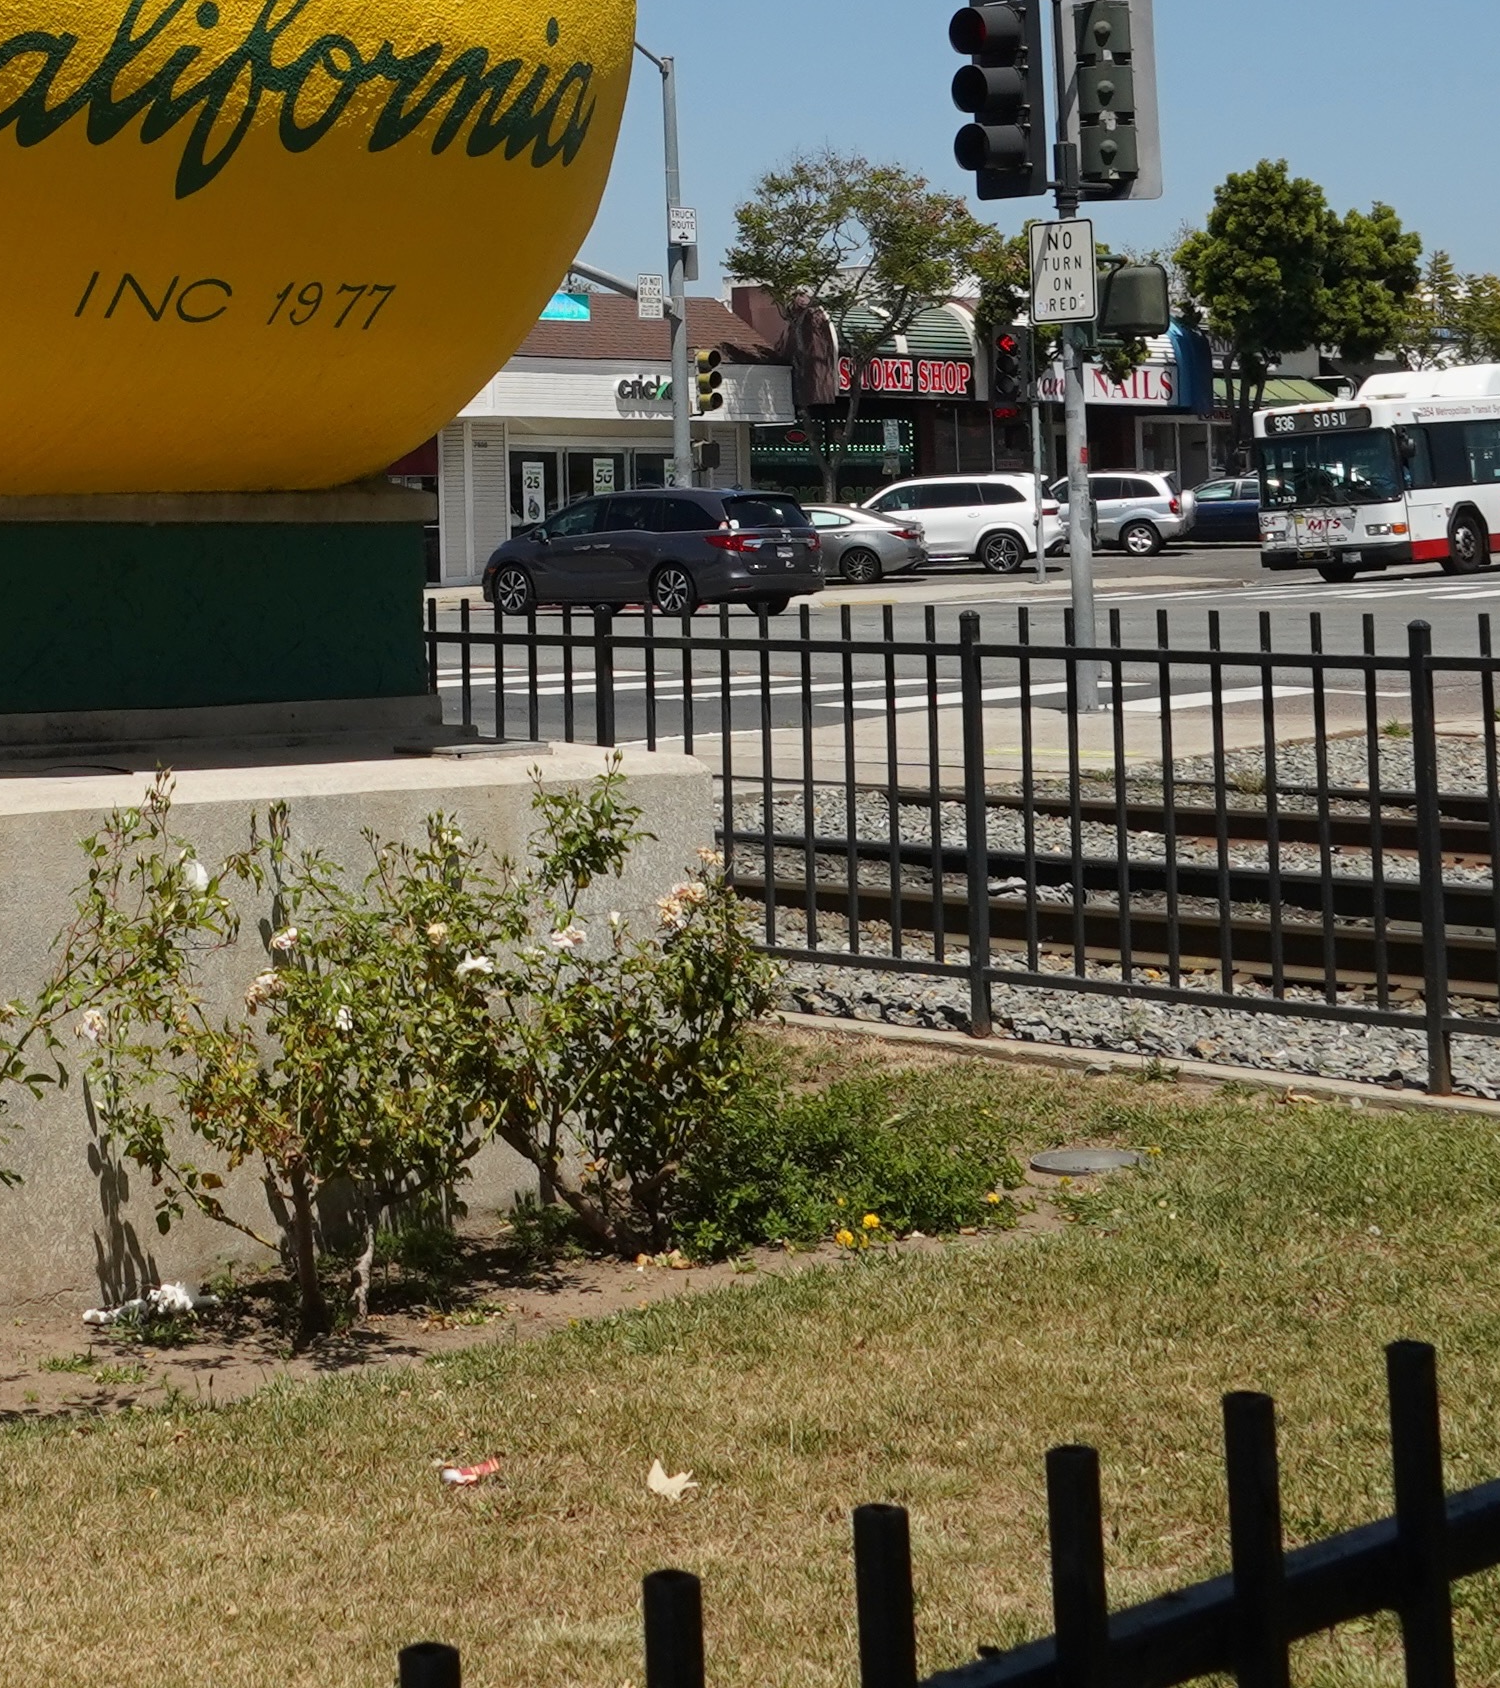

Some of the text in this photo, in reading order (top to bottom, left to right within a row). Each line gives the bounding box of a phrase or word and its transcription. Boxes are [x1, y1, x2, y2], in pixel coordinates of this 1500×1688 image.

[671, 210, 695, 219] TRUCK
[671, 220, 695, 230] ROUTE
[1047, 231, 1073, 252] NO
[1043, 255, 1083, 273] TURN
[639, 276, 661, 287] DO NOT
[1053, 277, 1073, 292] ON
[73, 269, 397, 330] INC 1977
[639, 286, 662, 297] BLOCK
[1049, 297, 1078, 313] RED
[917, 361, 971, 394] SHOP
[1090, 367, 1173, 401] NAILS
[617, 374, 673, 401] crick
[1273, 413, 1348, 432] 936 SDSU
[523, 475, 540, 489] $25
[594, 468, 613, 484] 5G
[1307, 518, 1341, 531] MTS
